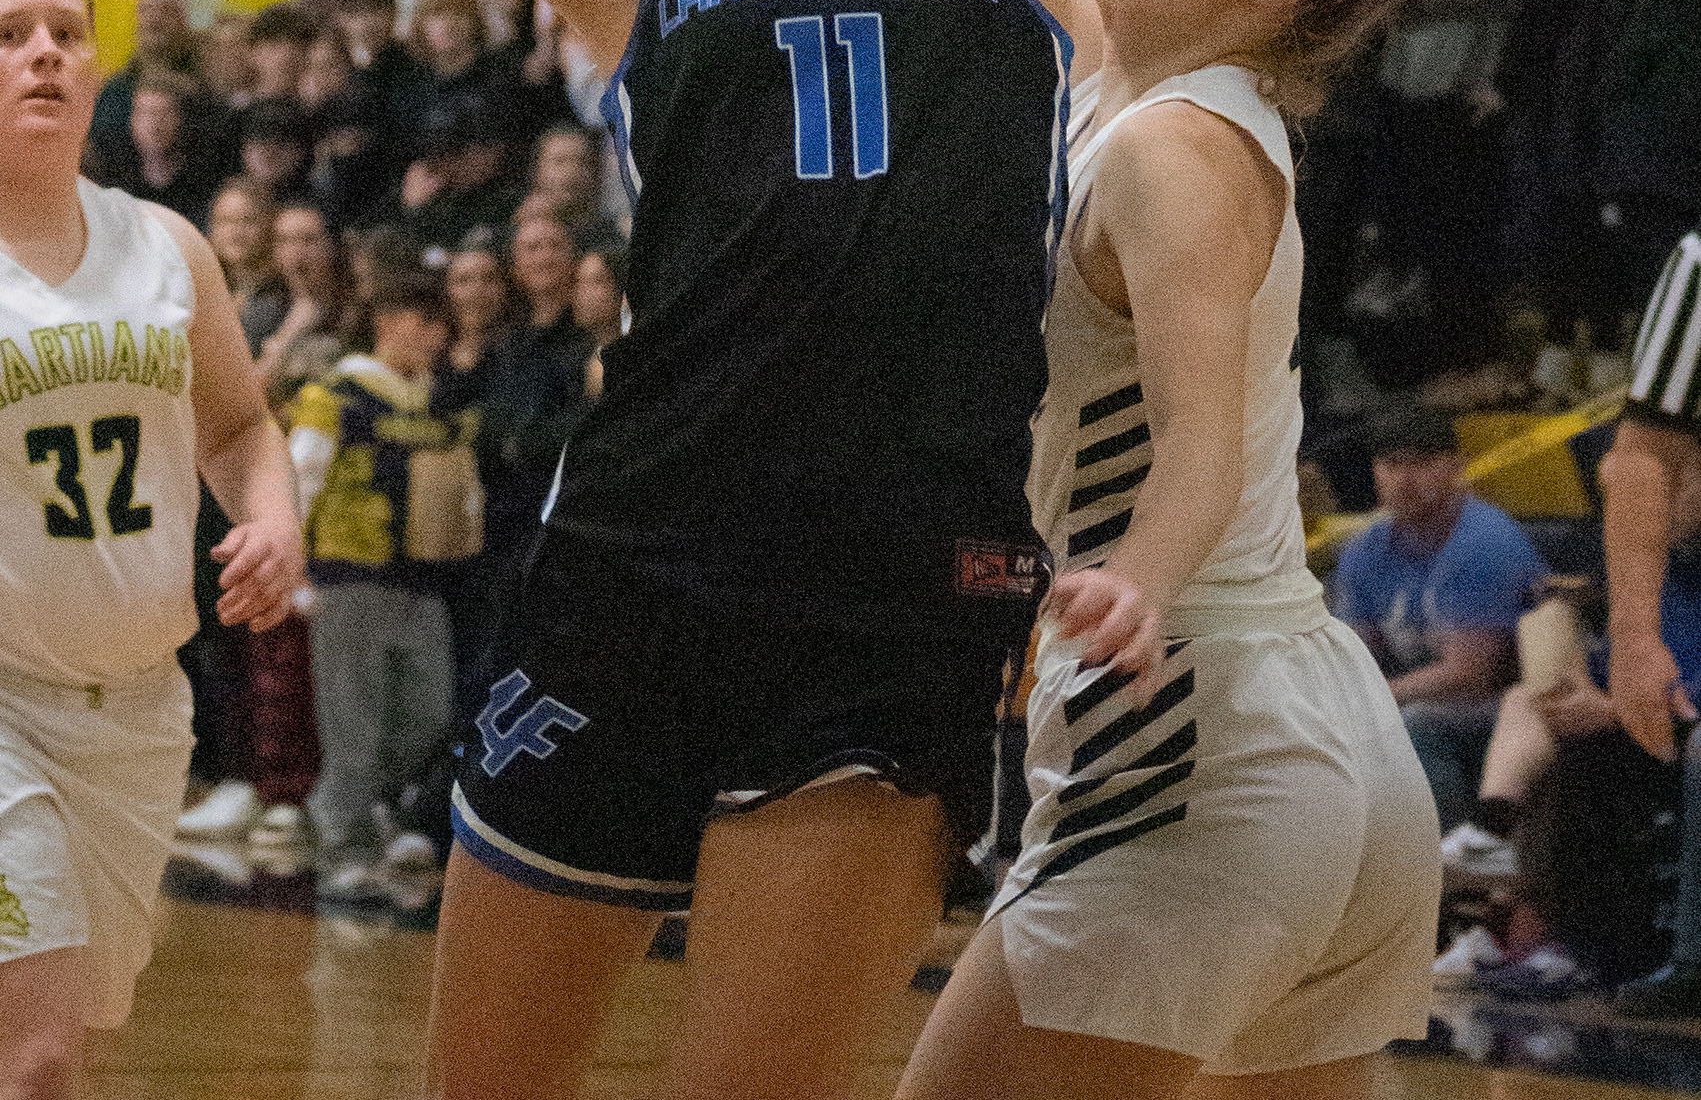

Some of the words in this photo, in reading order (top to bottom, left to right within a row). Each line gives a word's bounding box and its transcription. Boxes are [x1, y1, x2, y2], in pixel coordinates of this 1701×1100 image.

[774, 11, 890, 180] 11
[0, 320, 189, 409] ARTIANS
[24, 414, 153, 541] 32
